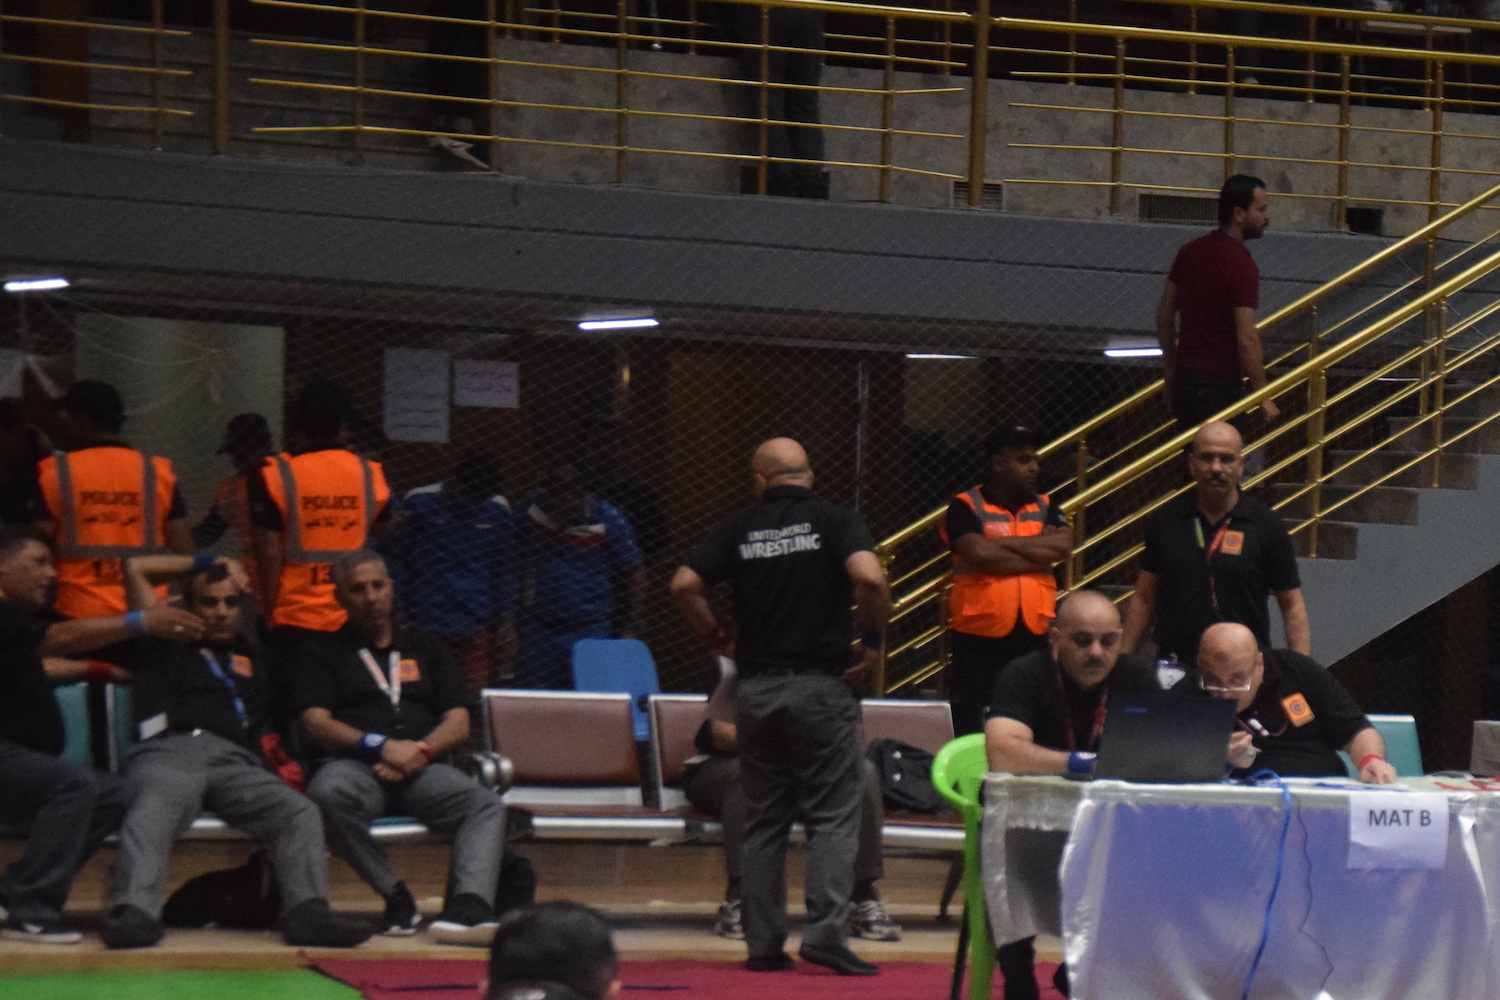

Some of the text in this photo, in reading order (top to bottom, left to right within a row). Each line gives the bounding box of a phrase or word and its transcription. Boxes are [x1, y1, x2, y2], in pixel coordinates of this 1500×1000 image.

[80, 491, 141, 506] POLICE
[302, 495, 359, 510] POLICE
[747, 522, 812, 541] UNITED WORLD
[739, 533, 821, 560] WRESTLING
[1368, 808, 1432, 828] MAT B
